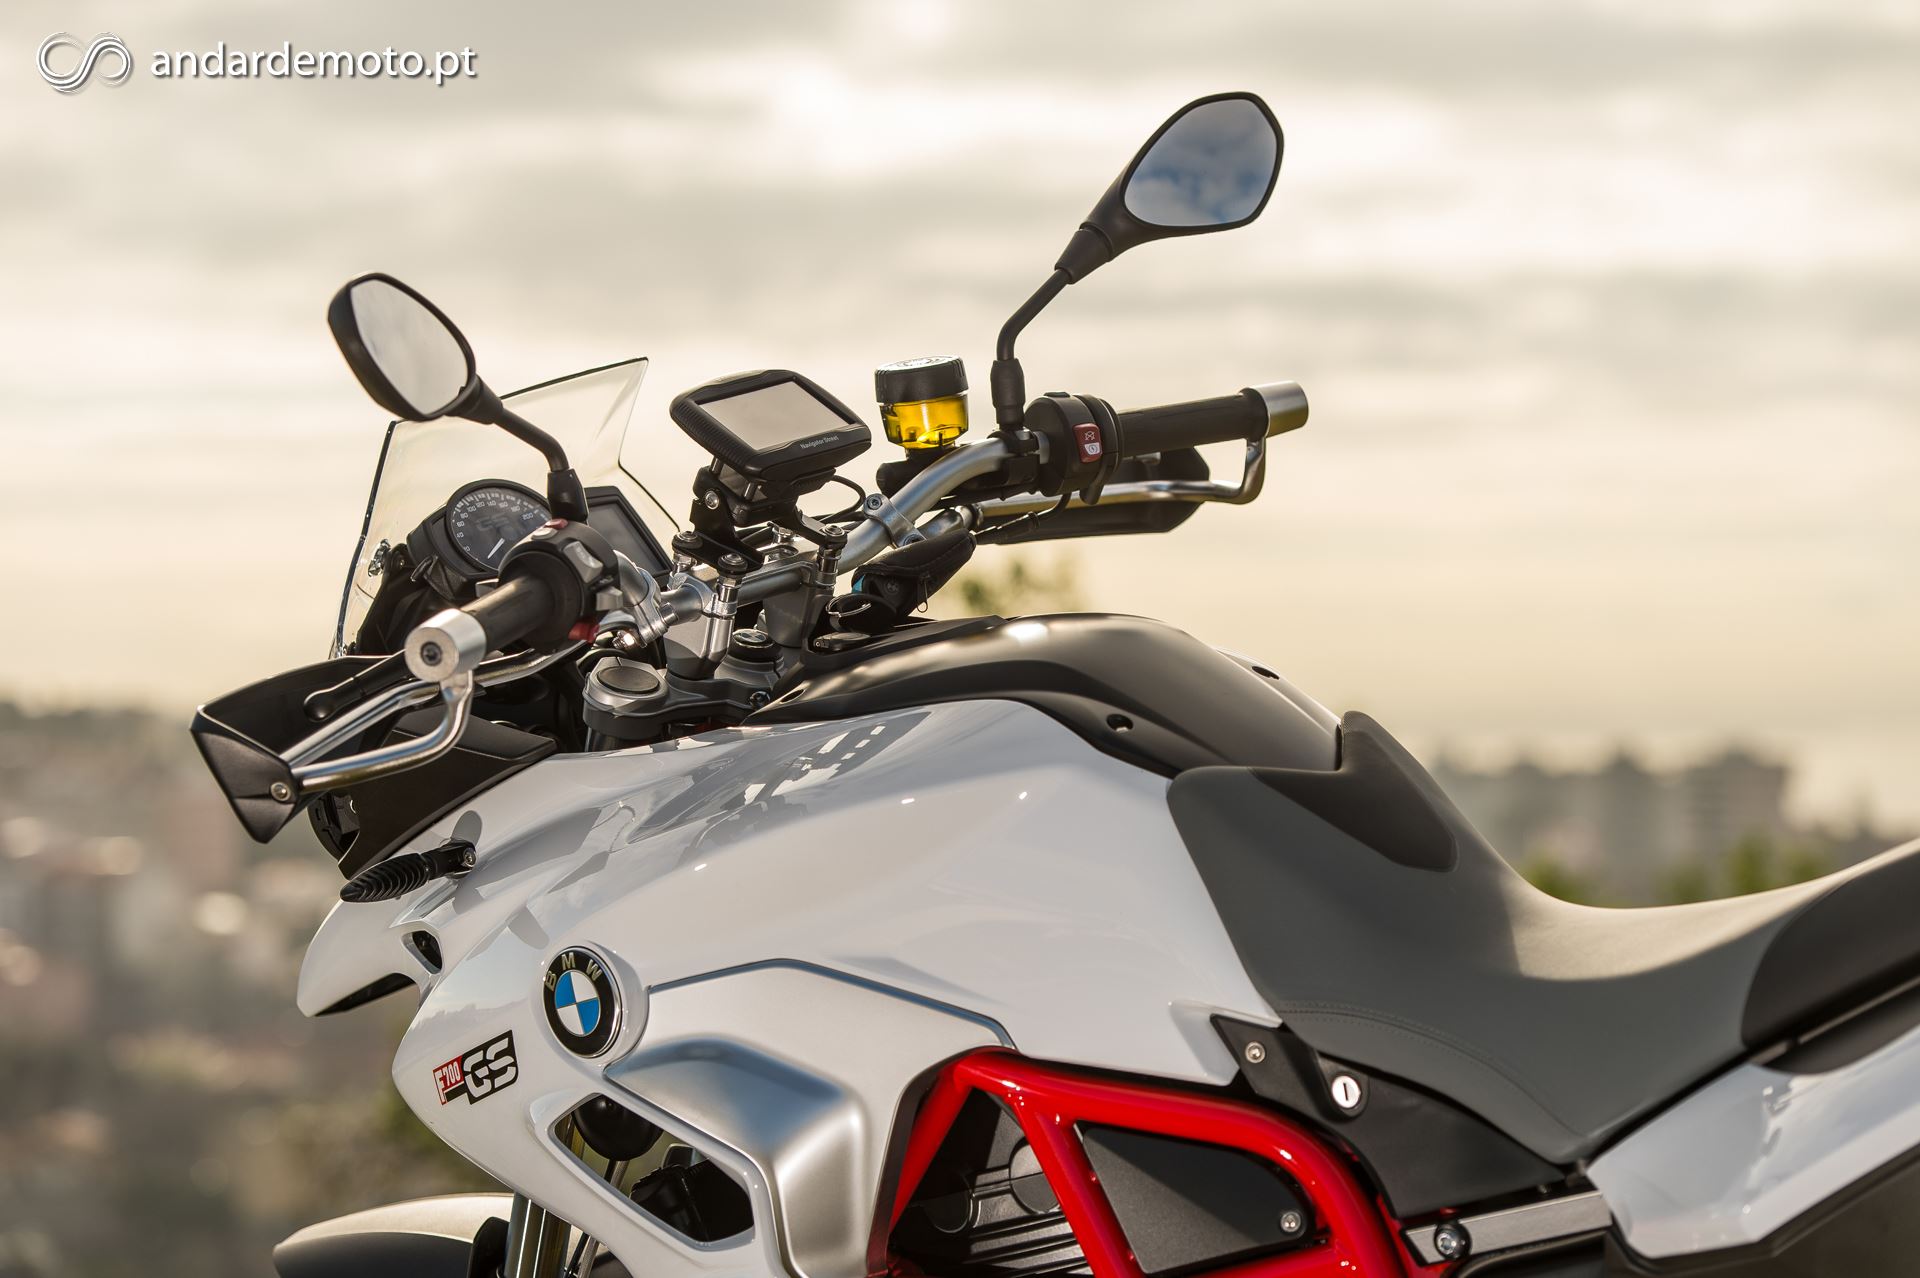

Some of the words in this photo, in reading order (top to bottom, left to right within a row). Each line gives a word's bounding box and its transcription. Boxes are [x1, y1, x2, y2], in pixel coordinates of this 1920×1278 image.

[800, 439, 824, 449] Navigator
[824, 435, 840, 443] Street
[544, 951, 602, 992] BMW
[463, 1037, 517, 1098] GS
